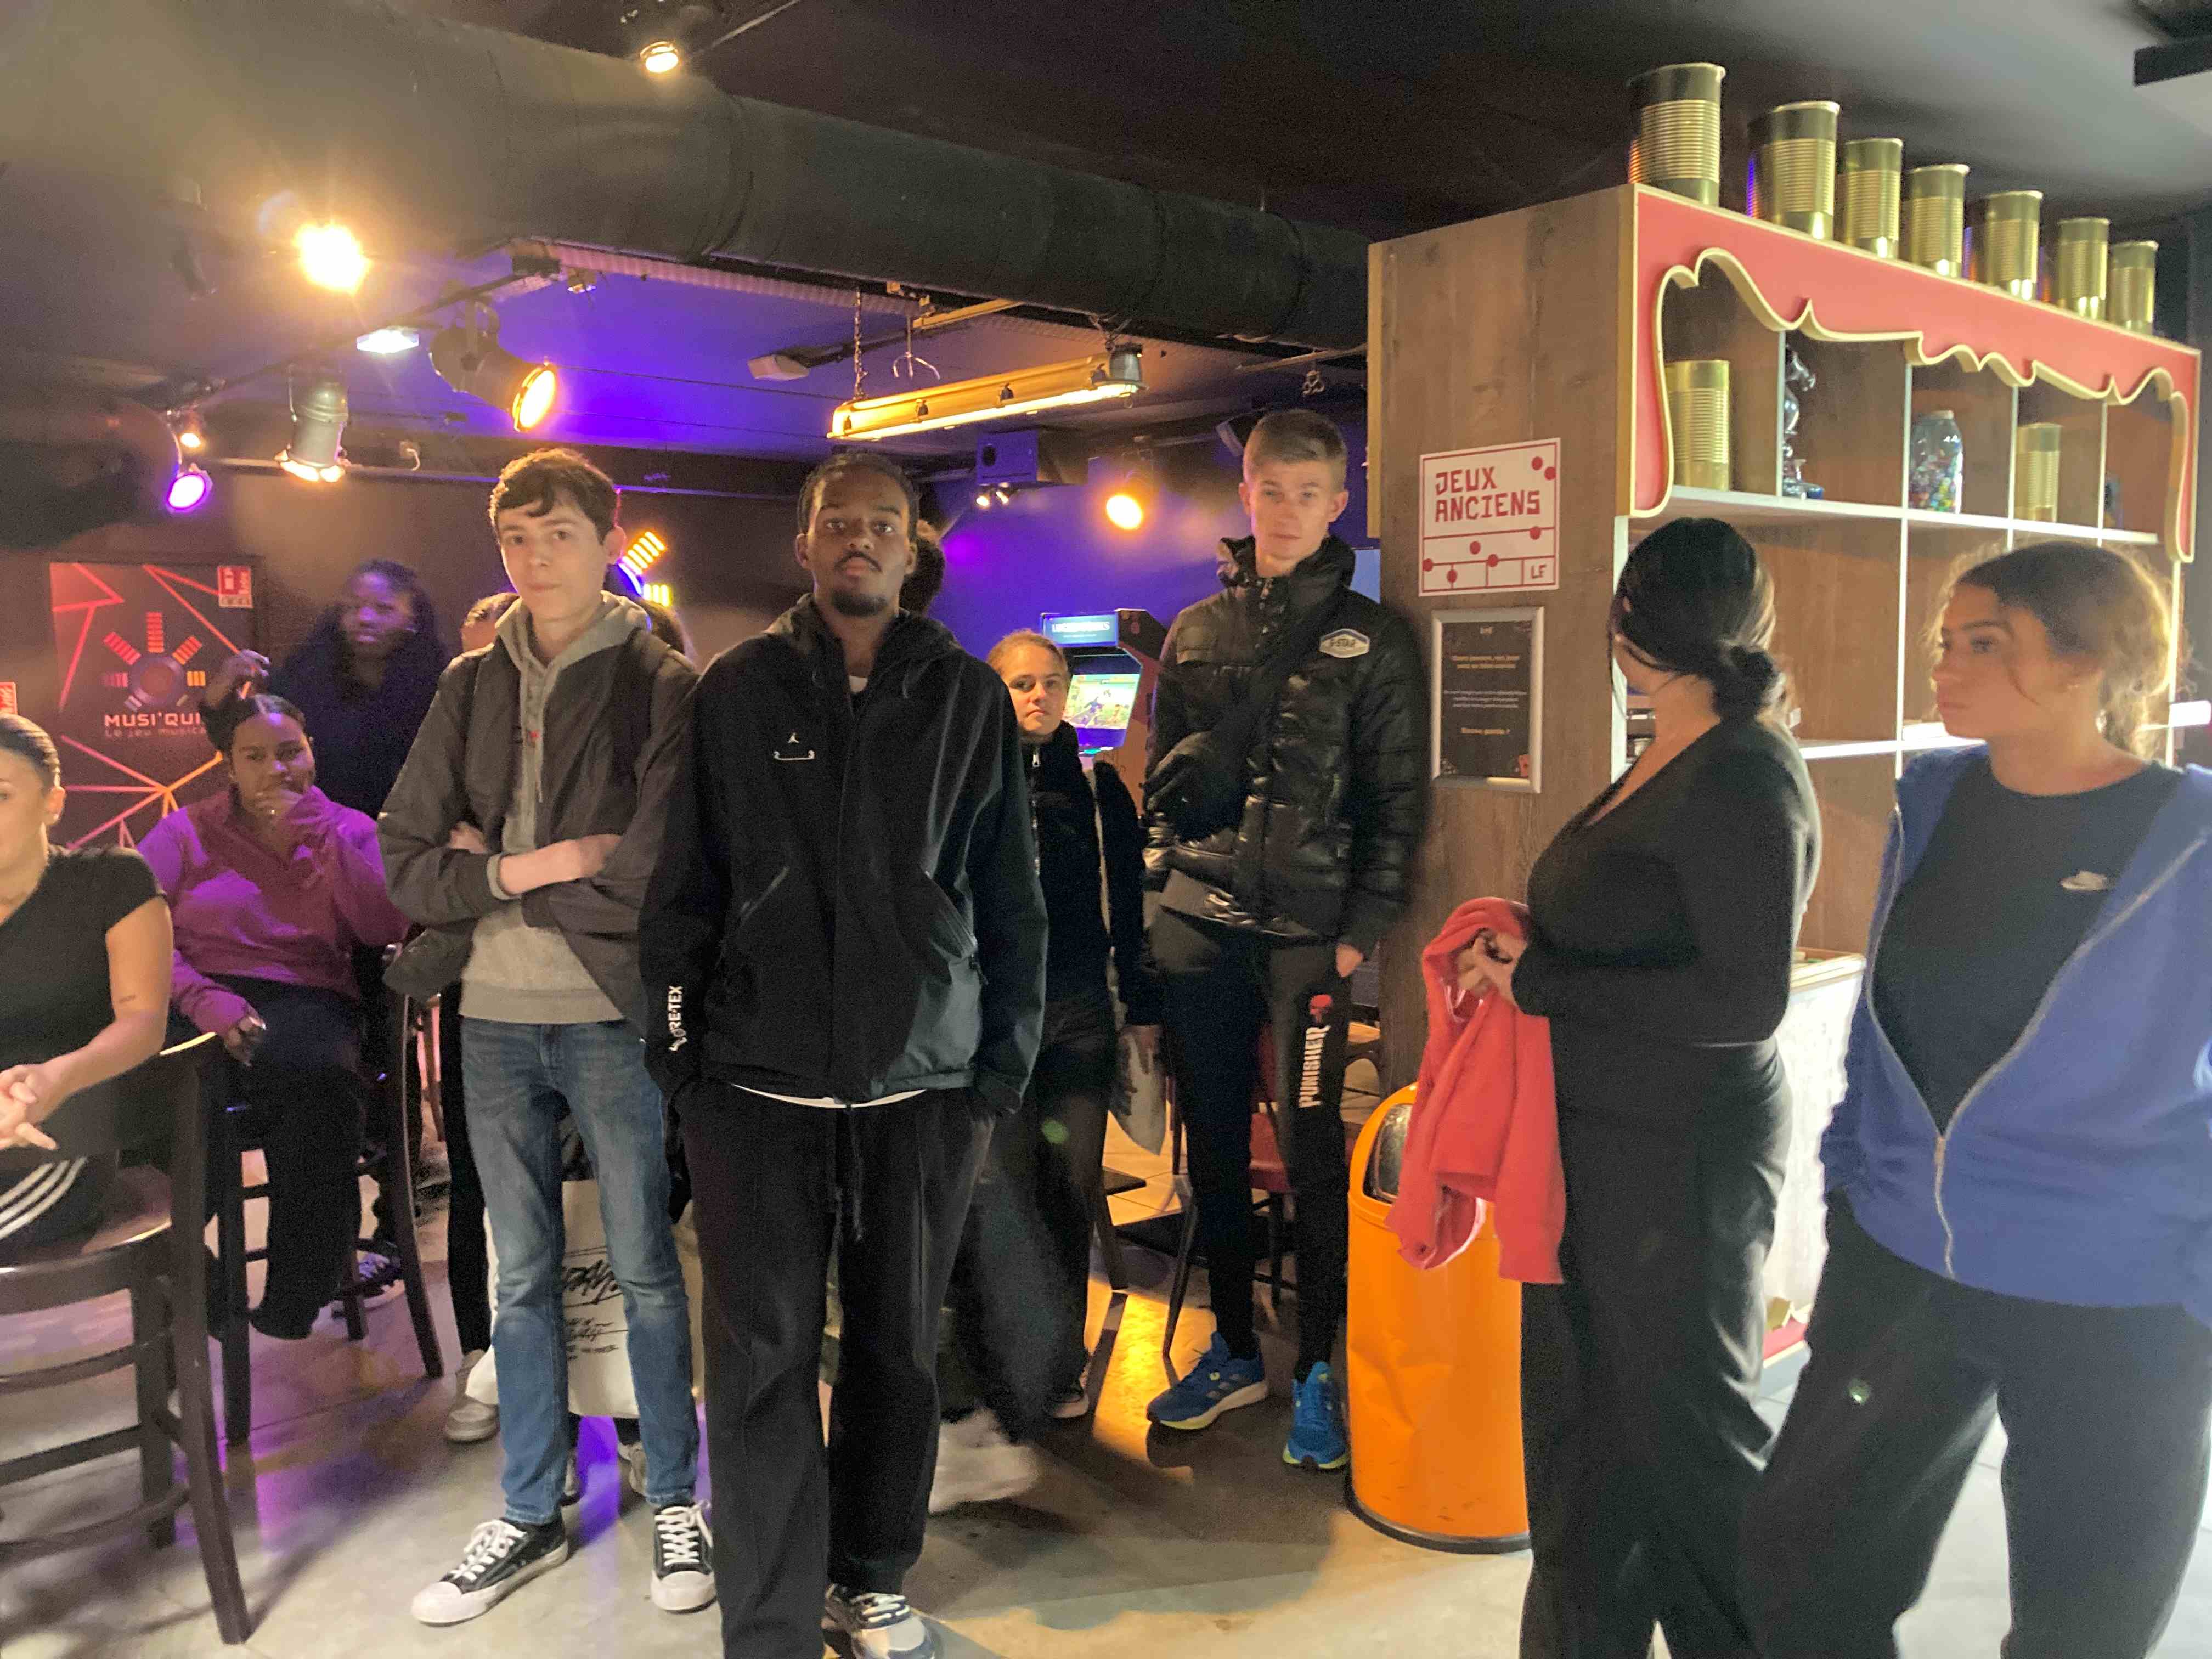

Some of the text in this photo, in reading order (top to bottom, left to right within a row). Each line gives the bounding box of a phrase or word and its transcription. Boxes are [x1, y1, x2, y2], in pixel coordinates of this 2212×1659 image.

[1435, 467, 1497, 495] JEUX
[1435, 490, 1541, 522] ANCIENS
[1531, 565, 1547, 579] LF
[104, 711, 201, 727] MUSI'QUI
